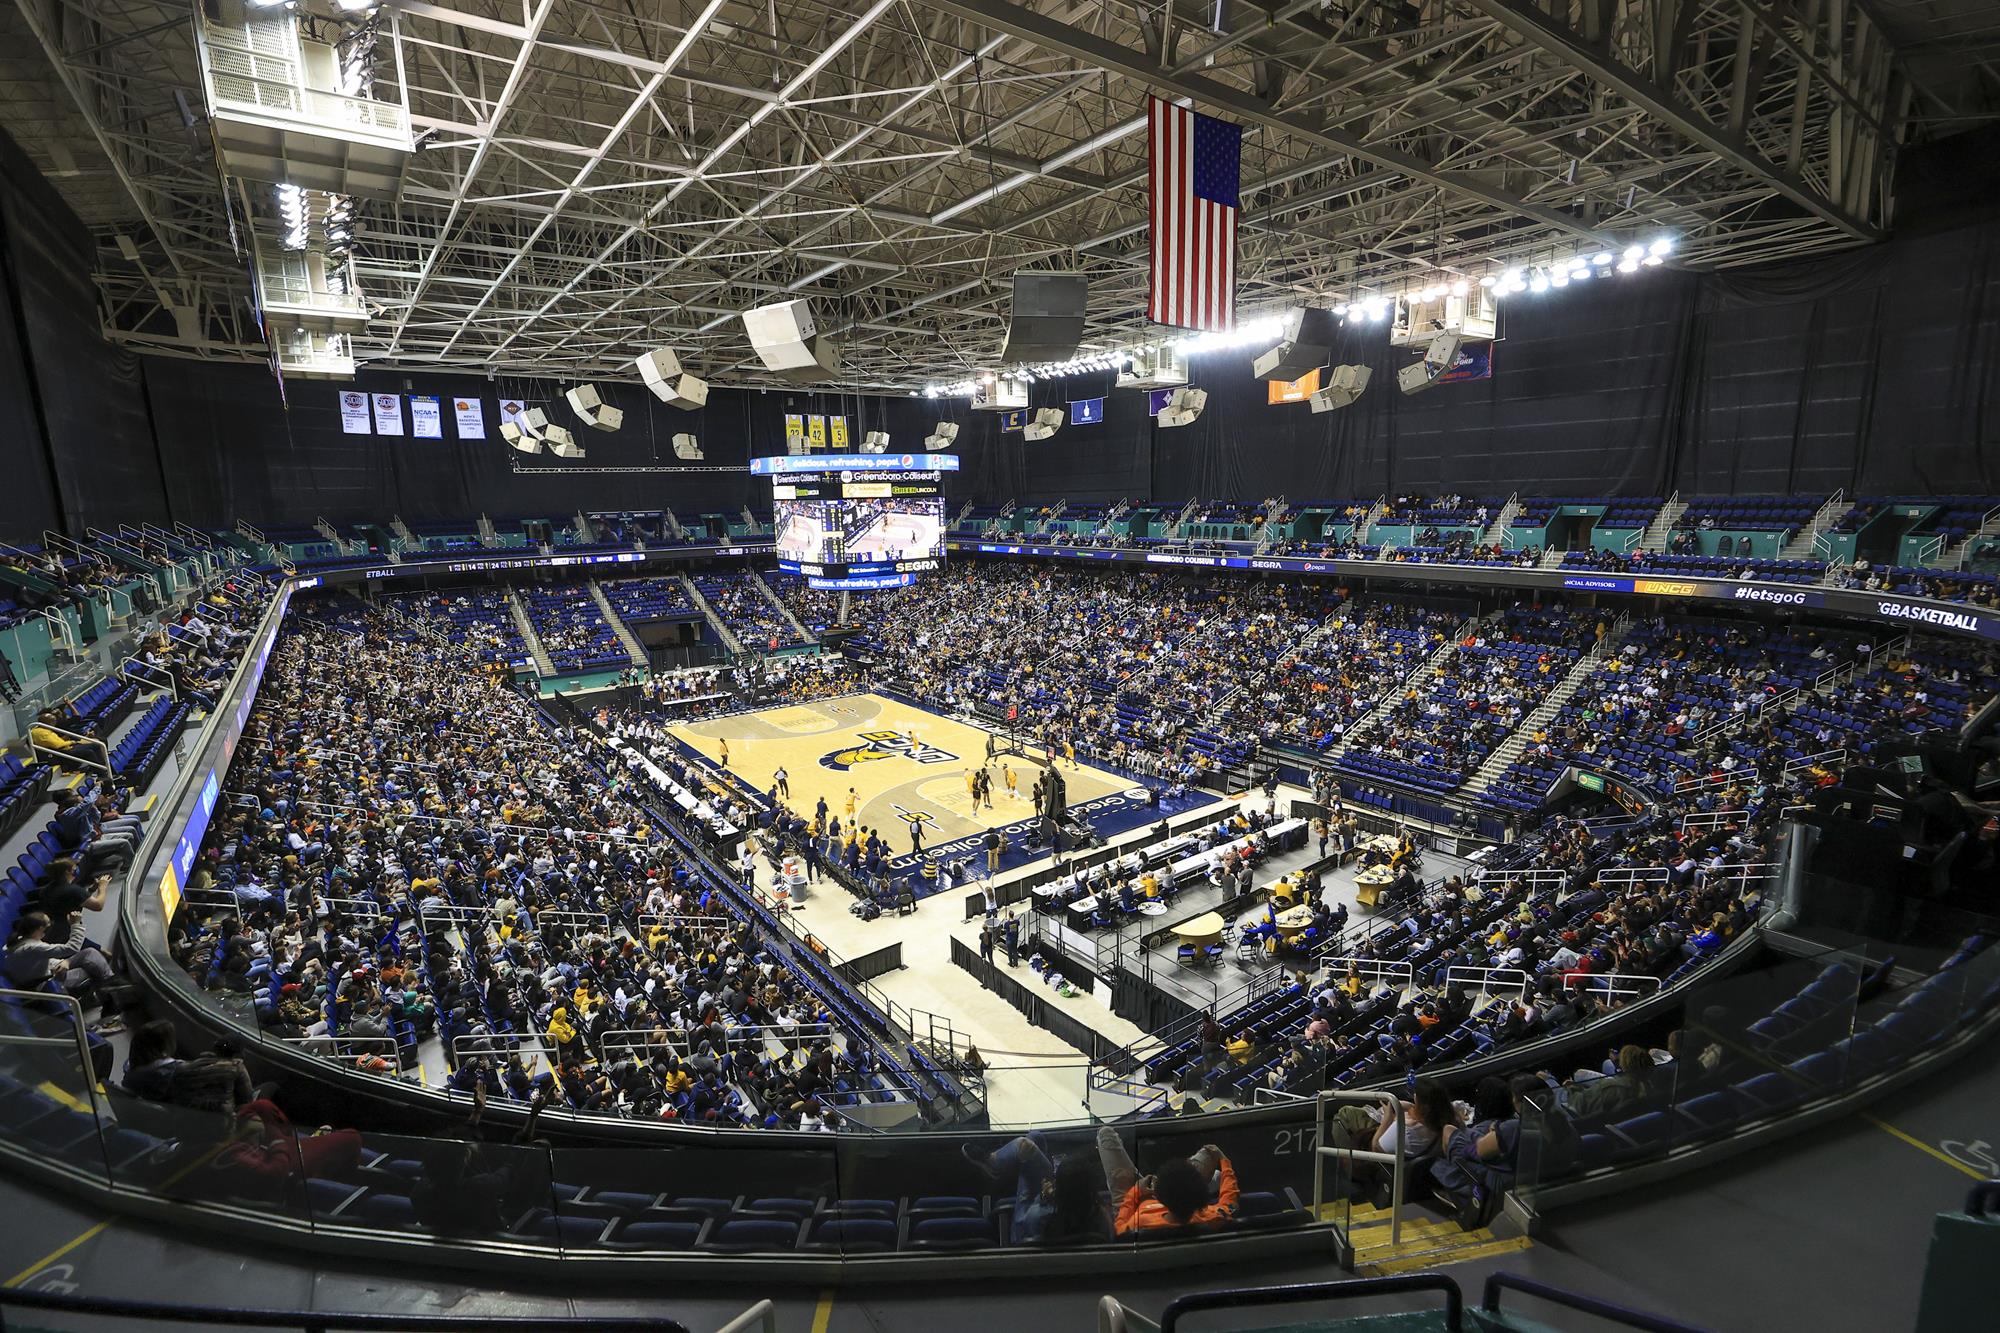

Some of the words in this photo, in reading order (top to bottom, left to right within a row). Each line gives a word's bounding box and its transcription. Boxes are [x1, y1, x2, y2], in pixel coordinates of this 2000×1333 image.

[854, 471, 901, 480] Greensboro
[903, 471, 939, 480] Coliseum
[1184, 557, 1215, 565] COLISEUM
[1252, 560, 1282, 569] SEGRA
[801, 564, 824, 577] SEGRA
[895, 561, 939, 573] SEGRA
[366, 569, 395, 578] ETBALL
[1645, 582, 1696, 595] UNCG
[1735, 587, 1806, 604] #letsgoG
